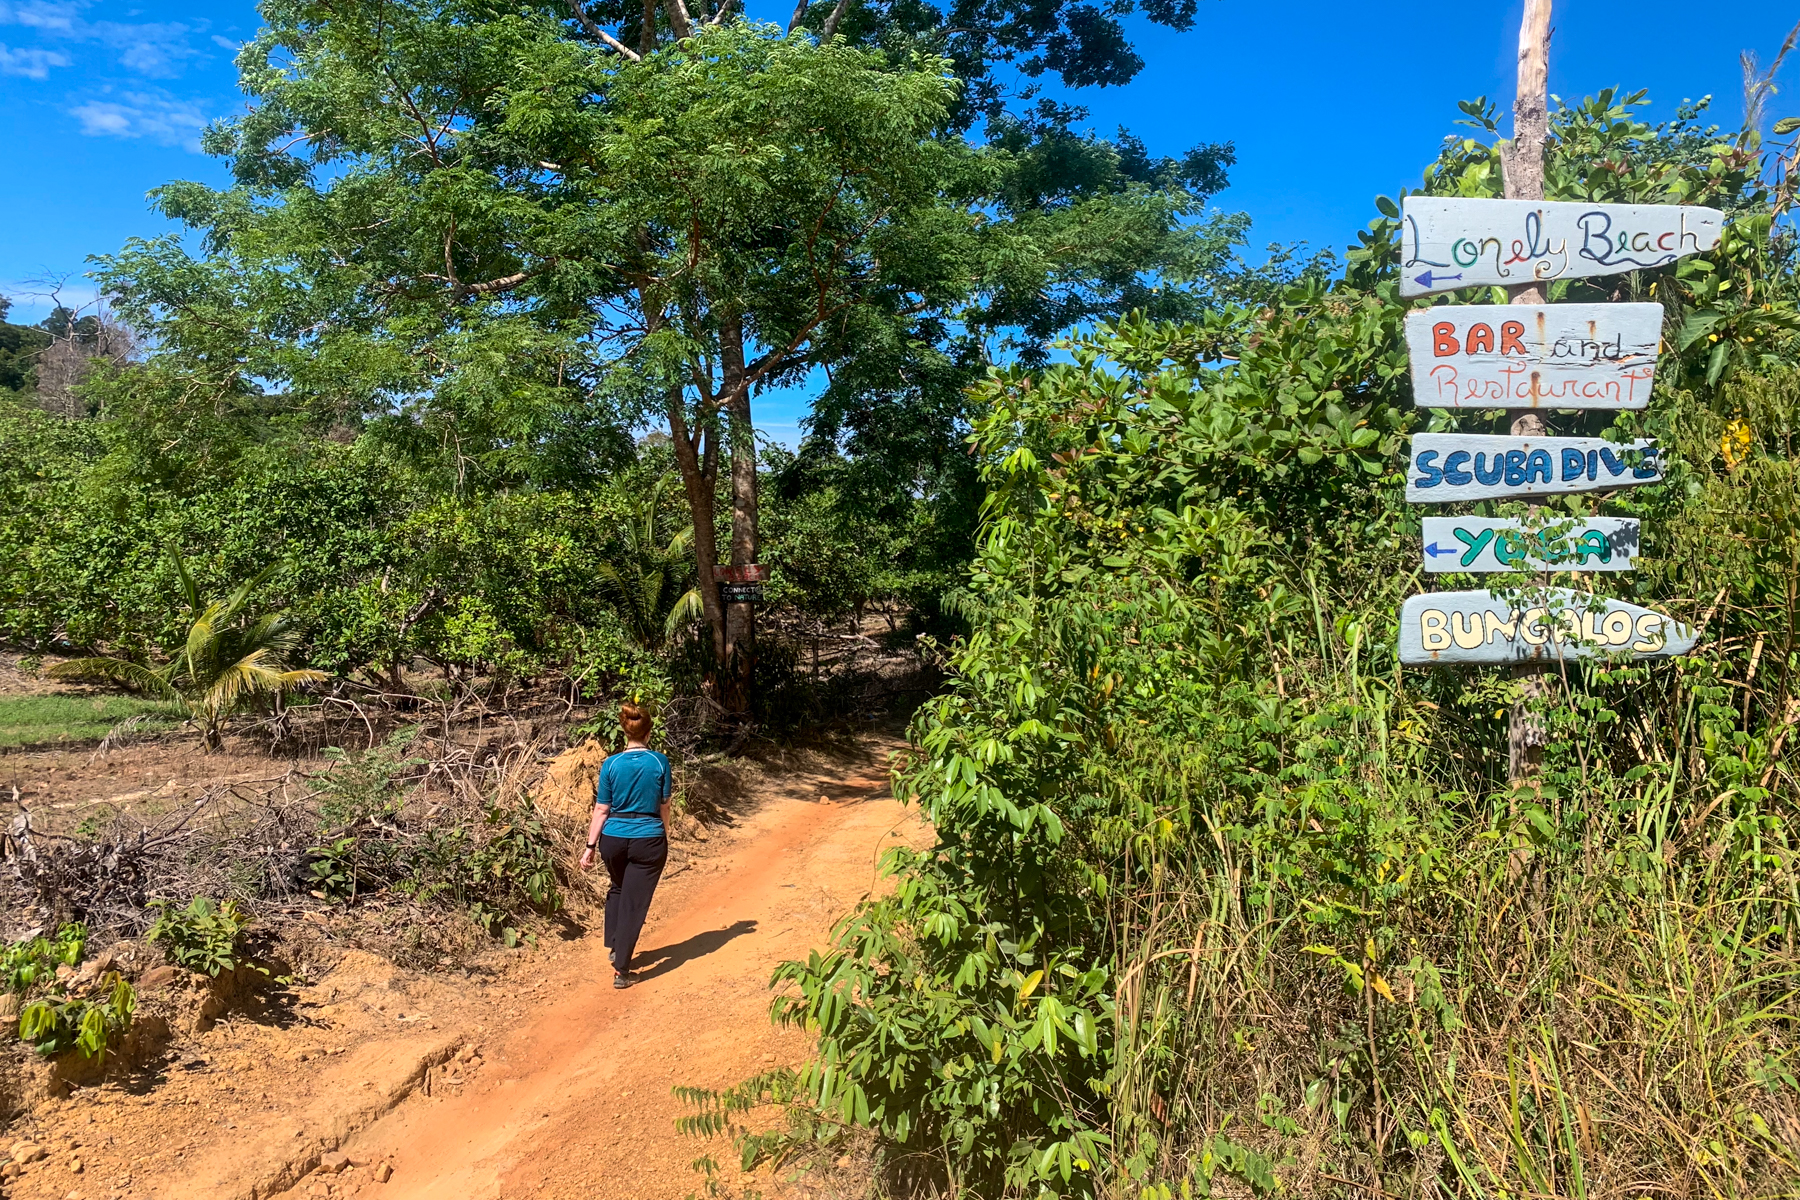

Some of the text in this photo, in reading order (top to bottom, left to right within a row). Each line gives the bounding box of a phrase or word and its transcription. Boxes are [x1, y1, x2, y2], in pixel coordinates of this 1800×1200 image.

[1405, 211, 1705, 281] Lonely Beach
[1432, 320, 1622, 360] BAR and
[1430, 361, 1653, 406] Restaurant
[1415, 446, 1659, 489] SCUBA DIVE
[1420, 607, 1665, 653] BUNGALOS
